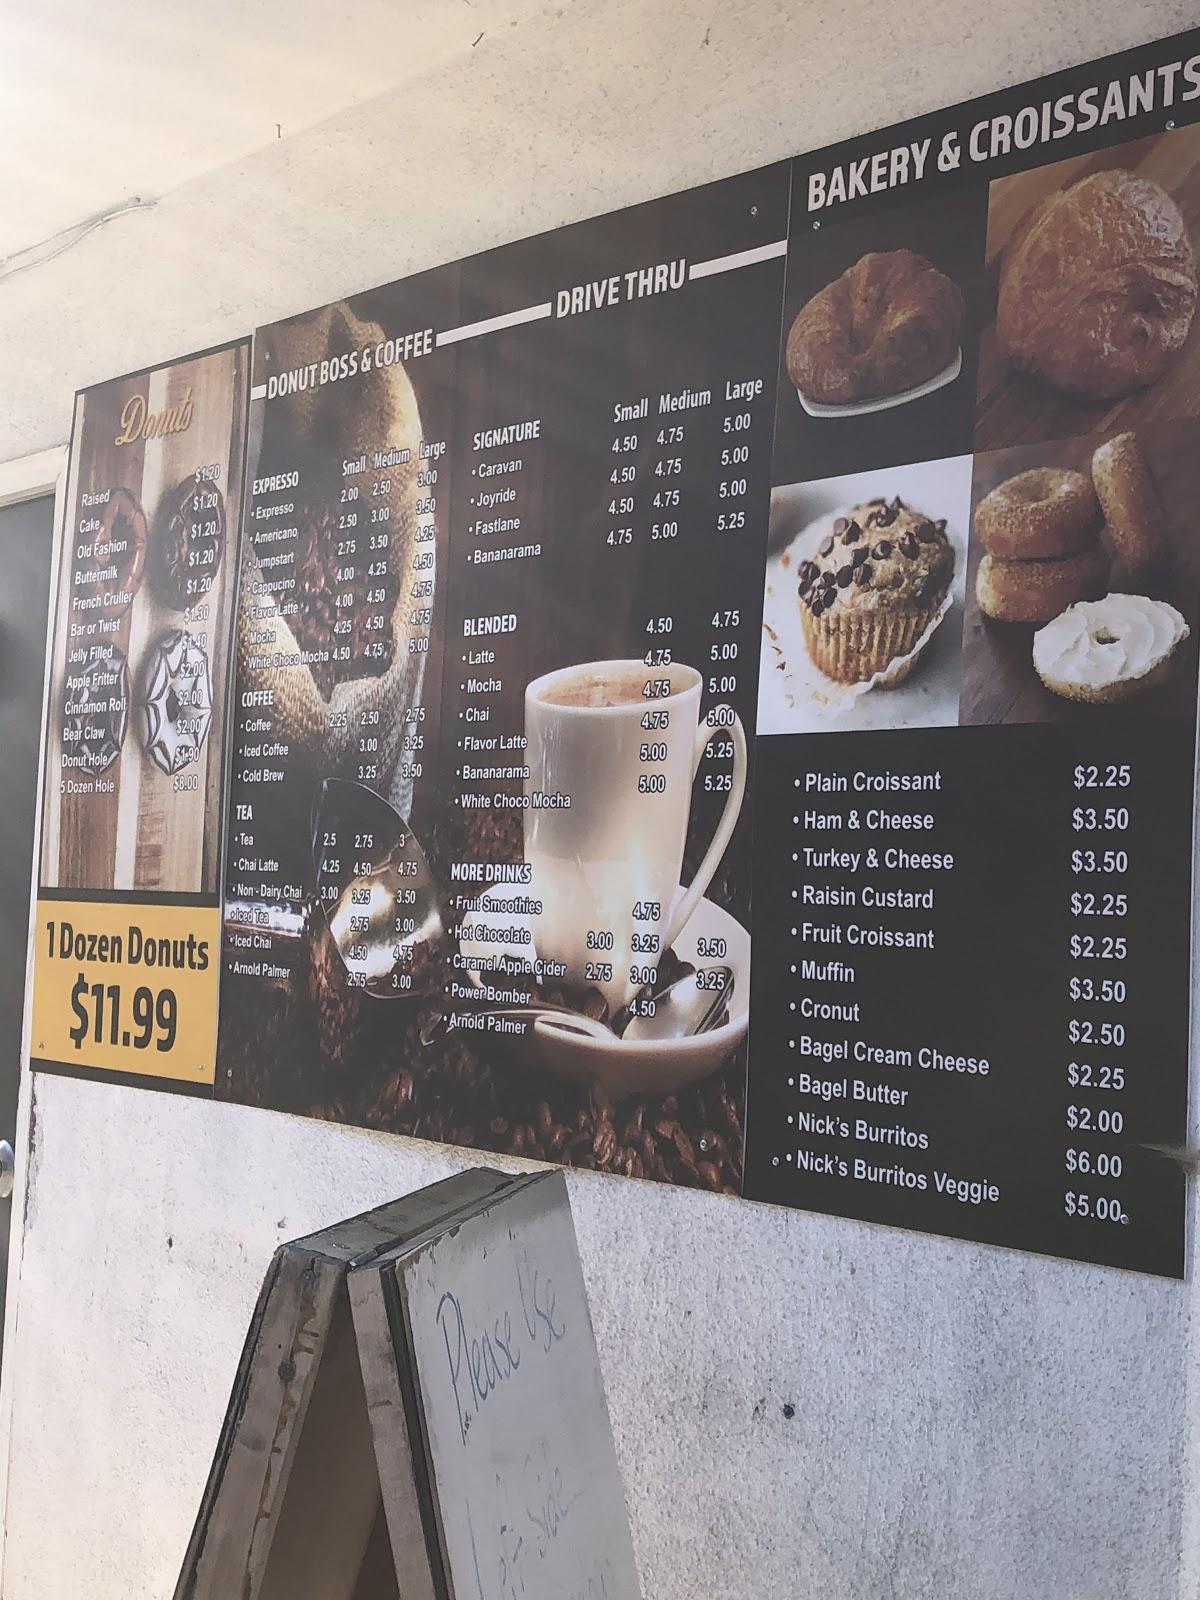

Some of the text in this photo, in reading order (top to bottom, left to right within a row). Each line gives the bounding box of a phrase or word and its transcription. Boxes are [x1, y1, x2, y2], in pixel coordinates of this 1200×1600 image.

[808, 54, 1200, 212] BAKERY & CROISSANTS
[268, 259, 686, 399] DONUT BOSS & COFFEE DRIVE THRU
[614, 378, 763, 423] Small Medium Large
[115, 387, 194, 445] Donuts
[473, 419, 540, 451] SIGNATURE
[612, 413, 751, 453] 4.50 4.75 5.00
[478, 458, 522, 478] Caravan
[610, 446, 749, 484] 4.50 4.75 5.00
[252, 471, 299, 495] EXPRESSO
[82, 489, 110, 507] Raised
[193, 493, 217, 511] $1.20
[477, 488, 516, 508] Joyride
[609, 479, 746, 515] 4.50 4.75 5.00
[256, 503, 294, 520] Expresso
[80, 519, 100, 534] Cake
[191, 522, 215, 539] $1.20
[254, 527, 298, 545] Americano
[475, 516, 520, 536] Fastlane
[607, 511, 744, 546] 4.75 5.00 5.25
[78, 540, 127, 558] Old Fashion
[189, 549, 213, 566] $1.20
[474, 543, 541, 564] Bananarama
[75, 566, 118, 584] Buttermilk
[73, 591, 132, 611] French Cruller
[71, 619, 120, 637] Bar or Twist
[463, 614, 517, 637] BLENDED
[646, 610, 740, 634] 4.50 4.75
[69, 645, 112, 663] Jelly Filled
[468, 650, 495, 665] Latte
[710, 643, 738, 661] 5.00
[66, 673, 118, 691] Apple Fritter
[467, 678, 501, 694] Mocha
[709, 676, 736, 694] 5.00
[65, 697, 126, 715] Cinnamon Roll
[242, 690, 273, 707] COFFEE
[466, 707, 489, 722] Chai
[707, 709, 734, 727] 5.00
[63, 726, 104, 741] Bear Claw
[245, 719, 271, 732] Coffee
[244, 744, 288, 757] Iced Coffee
[464, 734, 527, 751] Flavor Latte
[706, 742, 733, 759] 5.25
[61, 753, 107, 767] Donut Hole
[243, 770, 284, 782] Cold Brew
[463, 764, 530, 780] Bananarama
[805, 770, 941, 792] Plain Croissant
[1074, 764, 1131, 790] $2.25
[67, 779, 92, 793] Dozen
[95, 779, 114, 792] Hole
[705, 775, 732, 792] 5.25
[461, 792, 571, 809] White Choco Mocha
[237, 805, 252, 820] TEA
[804, 809, 934, 830] Ham & Cheese
[1072, 807, 1128, 832] $3.50
[240, 834, 253, 846] Tea
[324, 833, 373, 848] 2.5 2.75
[238, 858, 279, 871] Chai Latte
[803, 848, 954, 872] Turkey & Cheese
[1071, 849, 1128, 874] $3.50
[451, 862, 532, 884] MORE DRINKS
[456, 896, 542, 915] Fruit Smoothies
[803, 885, 933, 909] Raisin Custard
[1071, 892, 1127, 916] $2.25
[632, 902, 660, 920] 4.75
[454, 924, 531, 944] Hot Chocolate
[802, 922, 934, 949] Fruit Croissant
[47, 922, 209, 970] 1 Dozen Donuts
[587, 932, 726, 958] 3.00 3.25 3.50
[1070, 934, 1127, 959] $2.25
[453, 954, 567, 977] Caramel Apple Cider
[802, 960, 855, 982] Muffin
[586, 964, 725, 990] 2.75 3.00 3.25
[451, 983, 531, 1005] Power Bomber
[1069, 978, 1126, 1003] $3.50
[70, 973, 177, 1052] $11.99
[628, 999, 655, 1017] 4.50
[801, 997, 859, 1022] Cronut
[449, 1012, 526, 1035] Arnold Palmer
[1068, 1019, 1125, 1046] $2.50
[800, 1035, 990, 1076] Bagel Cream Cheese
[1068, 1062, 1125, 1090] $2.25
[799, 1073, 908, 1106] Bagel Butter
[1067, 1105, 1123, 1134] $2.00
[798, 1111, 929, 1150] Nick's Burritos
[1066, 1148, 1122, 1178] $6.00
[797, 1150, 1000, 1204] Nick's Burritos Veggie
[1065, 1191, 1122, 1222] $5.00
[436, 1291, 520, 1446] Please
